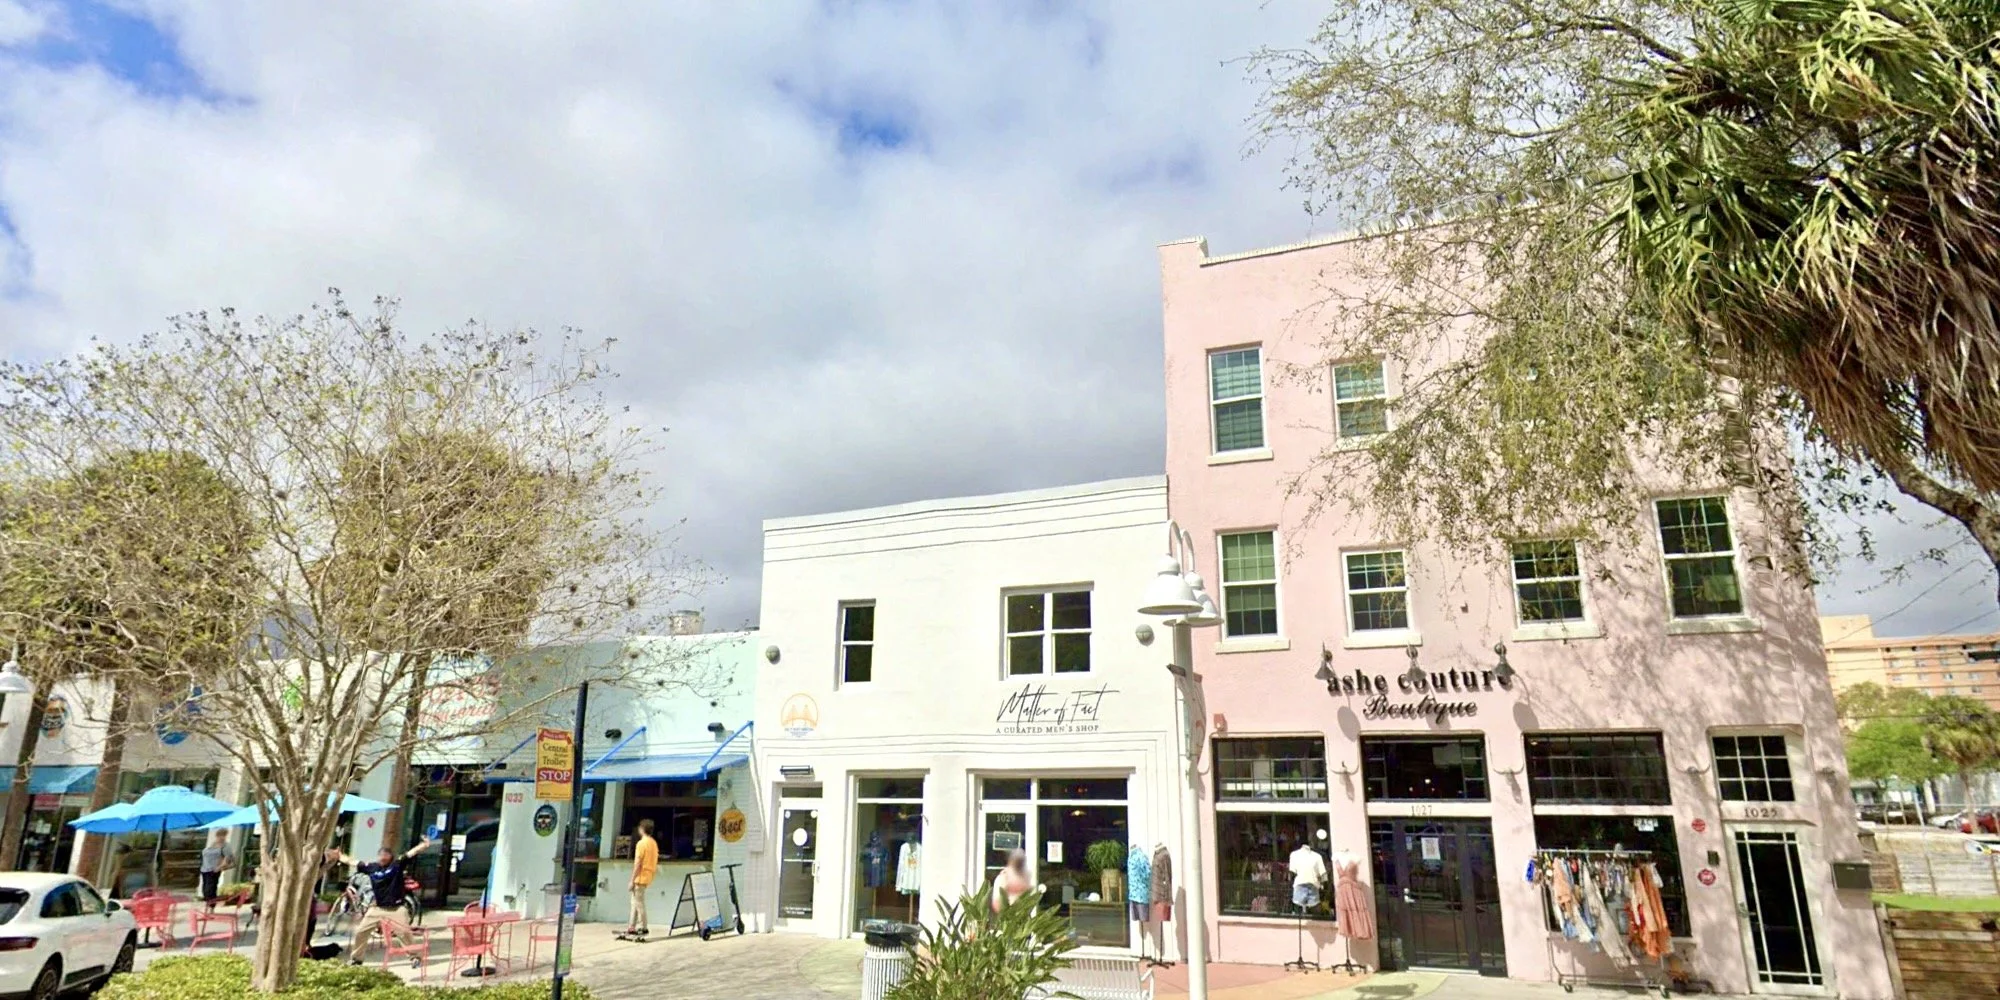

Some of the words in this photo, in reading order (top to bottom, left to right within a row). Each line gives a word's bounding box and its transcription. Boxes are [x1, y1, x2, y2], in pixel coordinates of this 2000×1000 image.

[1327, 668, 1387, 692] ashe
[996, 683, 1058, 729] Matter
[1054, 697, 1068, 725] of
[1071, 682, 1120, 723] Fact
[1363, 694, 1477, 725] Boutique
[1004, 726, 1043, 734] CURATED
[1046, 724, 1073, 733] MEN'S
[1076, 724, 1100, 732] SHOP
[542, 742, 568, 753] Central
[542, 755, 567, 768] Trolley
[539, 770, 571, 781] STOP
[996, 813, 1016, 823] 1029
[1744, 807, 1778, 818] 1025
